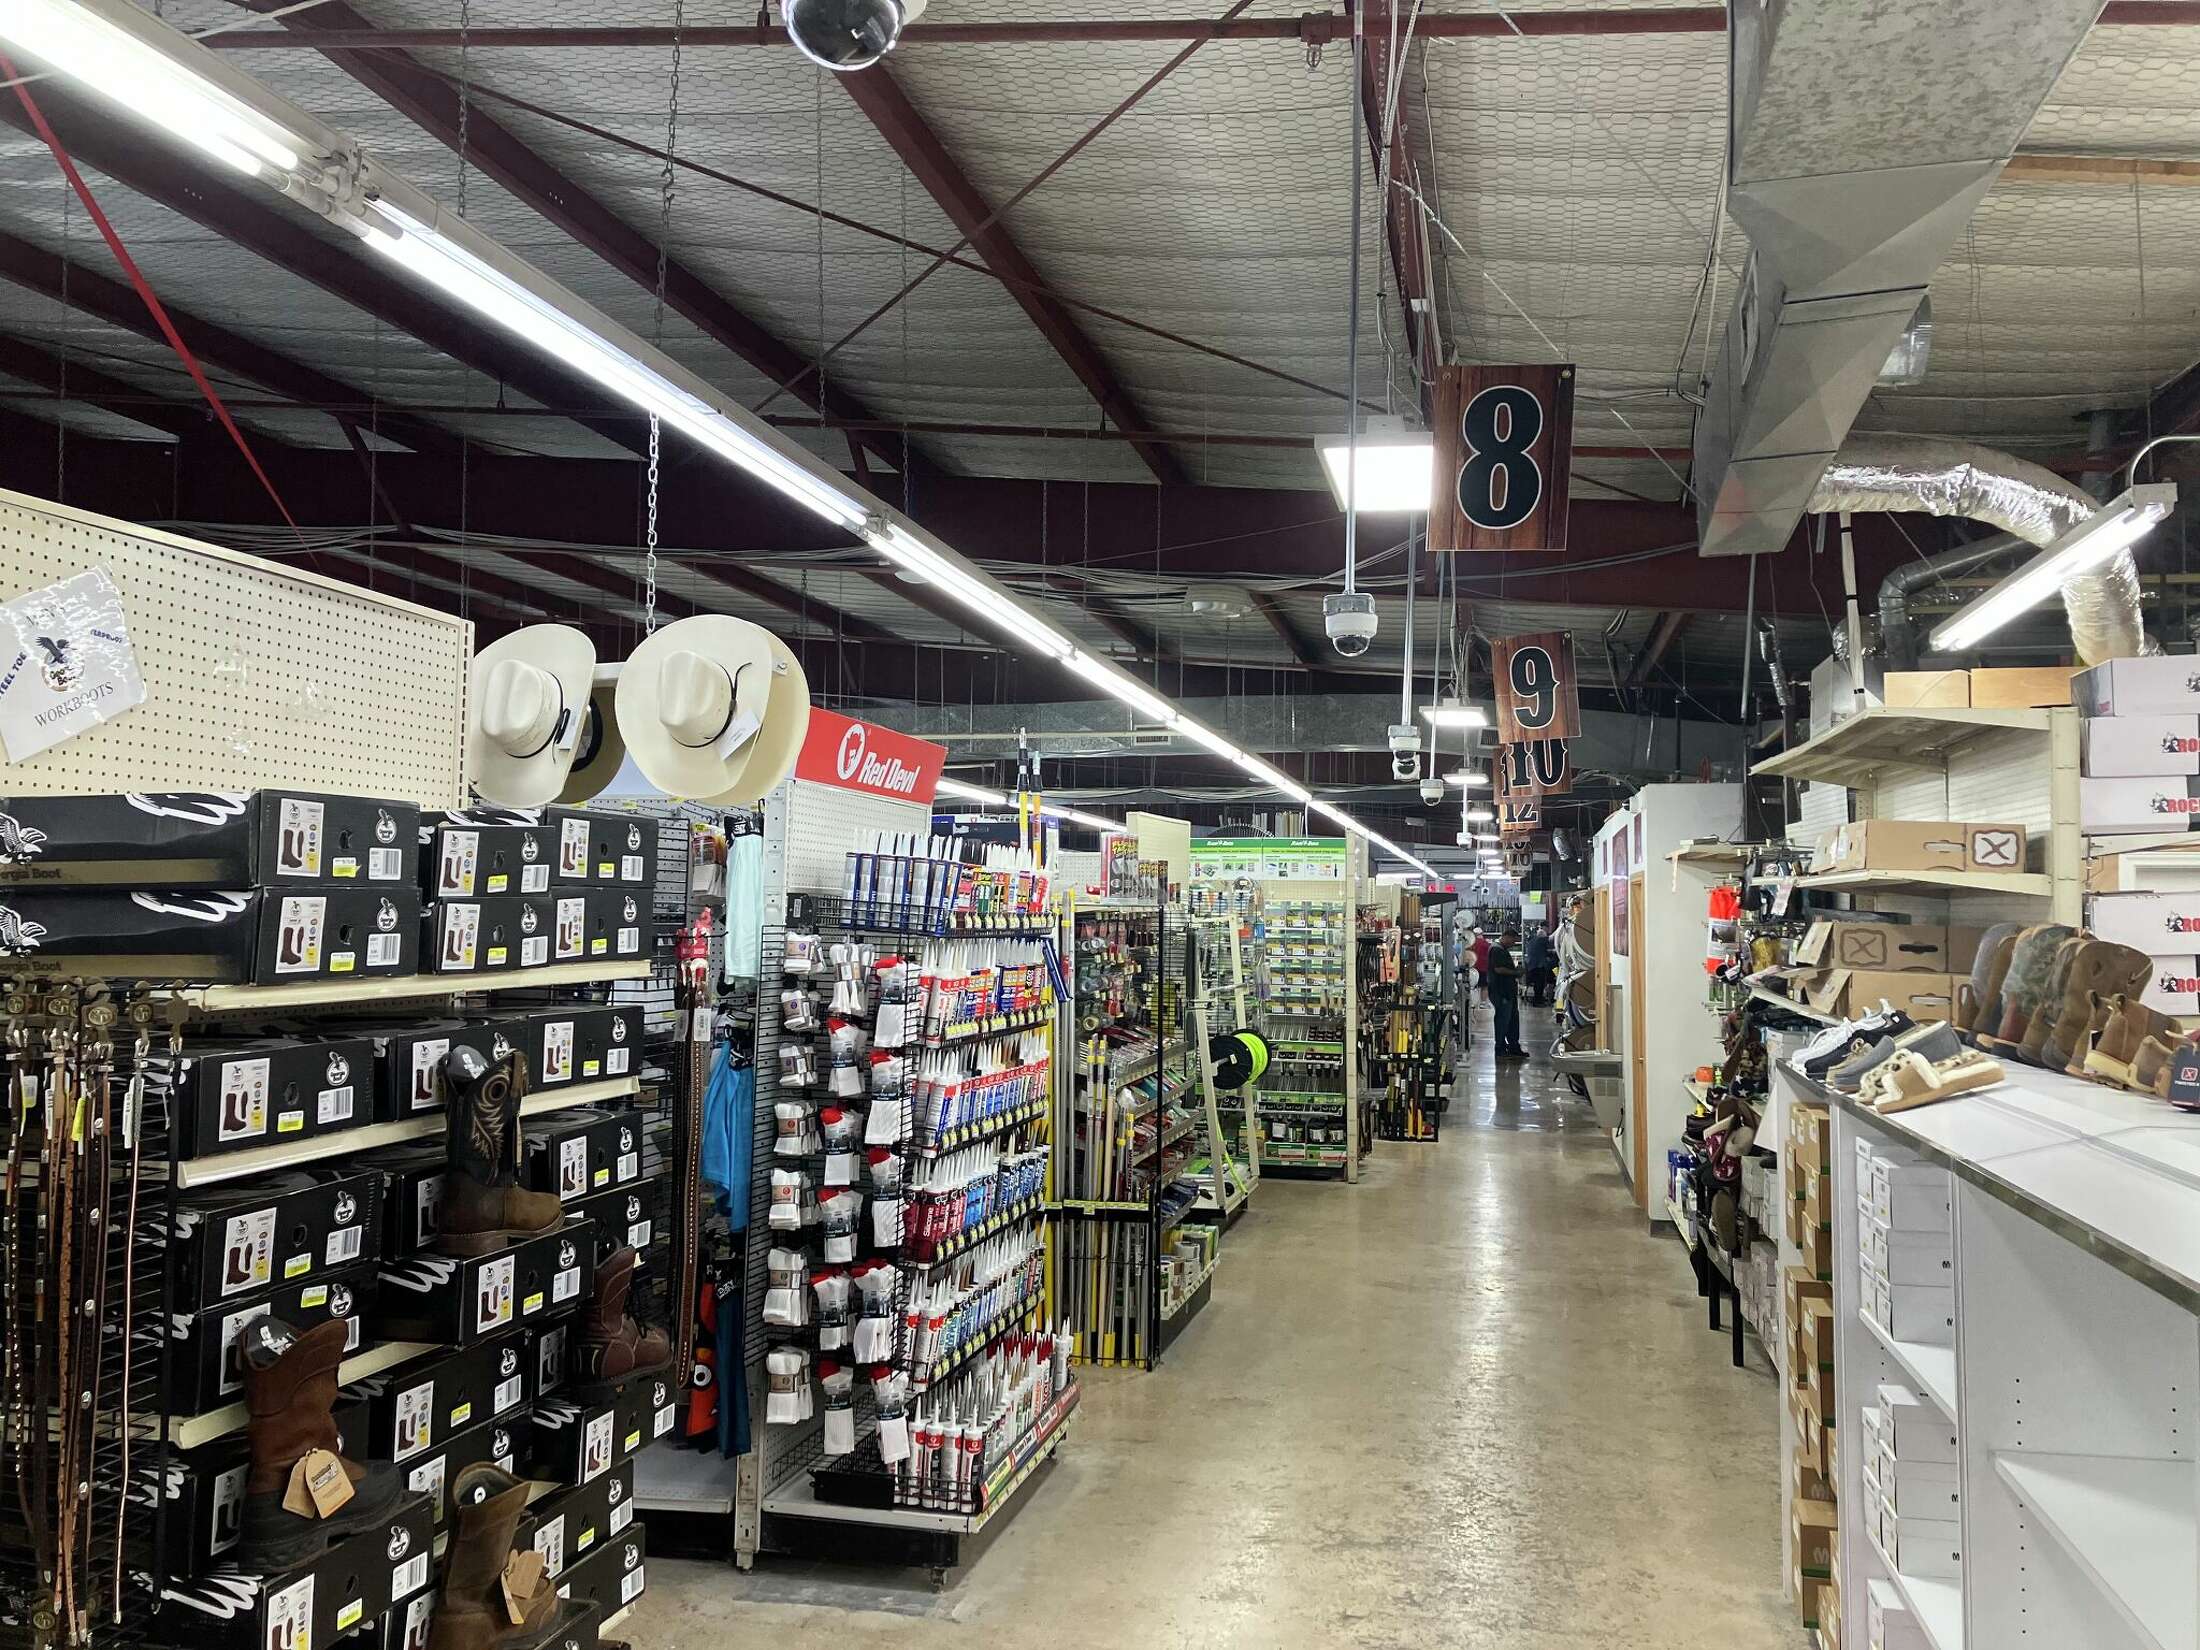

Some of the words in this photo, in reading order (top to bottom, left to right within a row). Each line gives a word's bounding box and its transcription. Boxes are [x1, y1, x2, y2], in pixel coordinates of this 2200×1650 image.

[1457, 385, 1543, 529] 8
[0, 673, 15, 699] TEEL
[12, 652, 27, 673] TOE
[1510, 646, 1560, 729] 9
[34, 681, 115, 728] WORKBOOTS
[2178, 738, 2200, 752] RO
[857, 751, 892, 787] Red
[883, 758, 921, 793] Devil
[2167, 799, 2200, 813] ROC
[0, 870, 30, 881] orgia
[32, 868, 62, 878] Boot
[0, 961, 30, 973] orgia
[2176, 977, 2200, 992] RO
